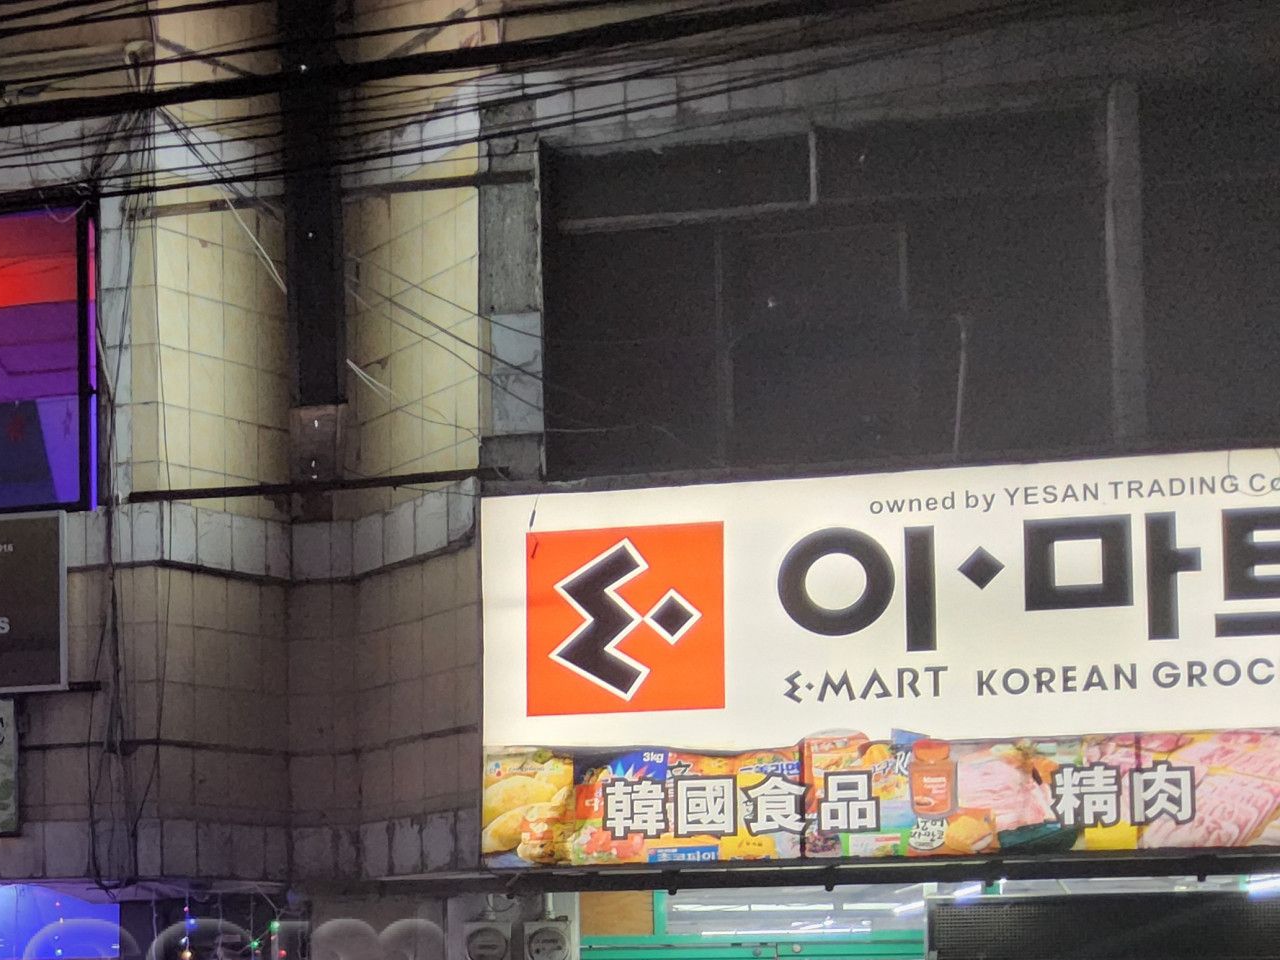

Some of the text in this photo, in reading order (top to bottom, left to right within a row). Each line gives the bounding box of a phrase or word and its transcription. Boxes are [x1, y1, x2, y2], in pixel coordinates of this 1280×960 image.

[869, 491, 955, 515] owned
[965, 489, 996, 512] by
[1003, 483, 1099, 507] YESAN
[1108, 474, 1240, 499] TRADING
[976, 662, 1138, 697] KOREAN
[642, 752, 664, 764] 3kg
[604, 763, 1194, 839] 韓國食品 精肉
